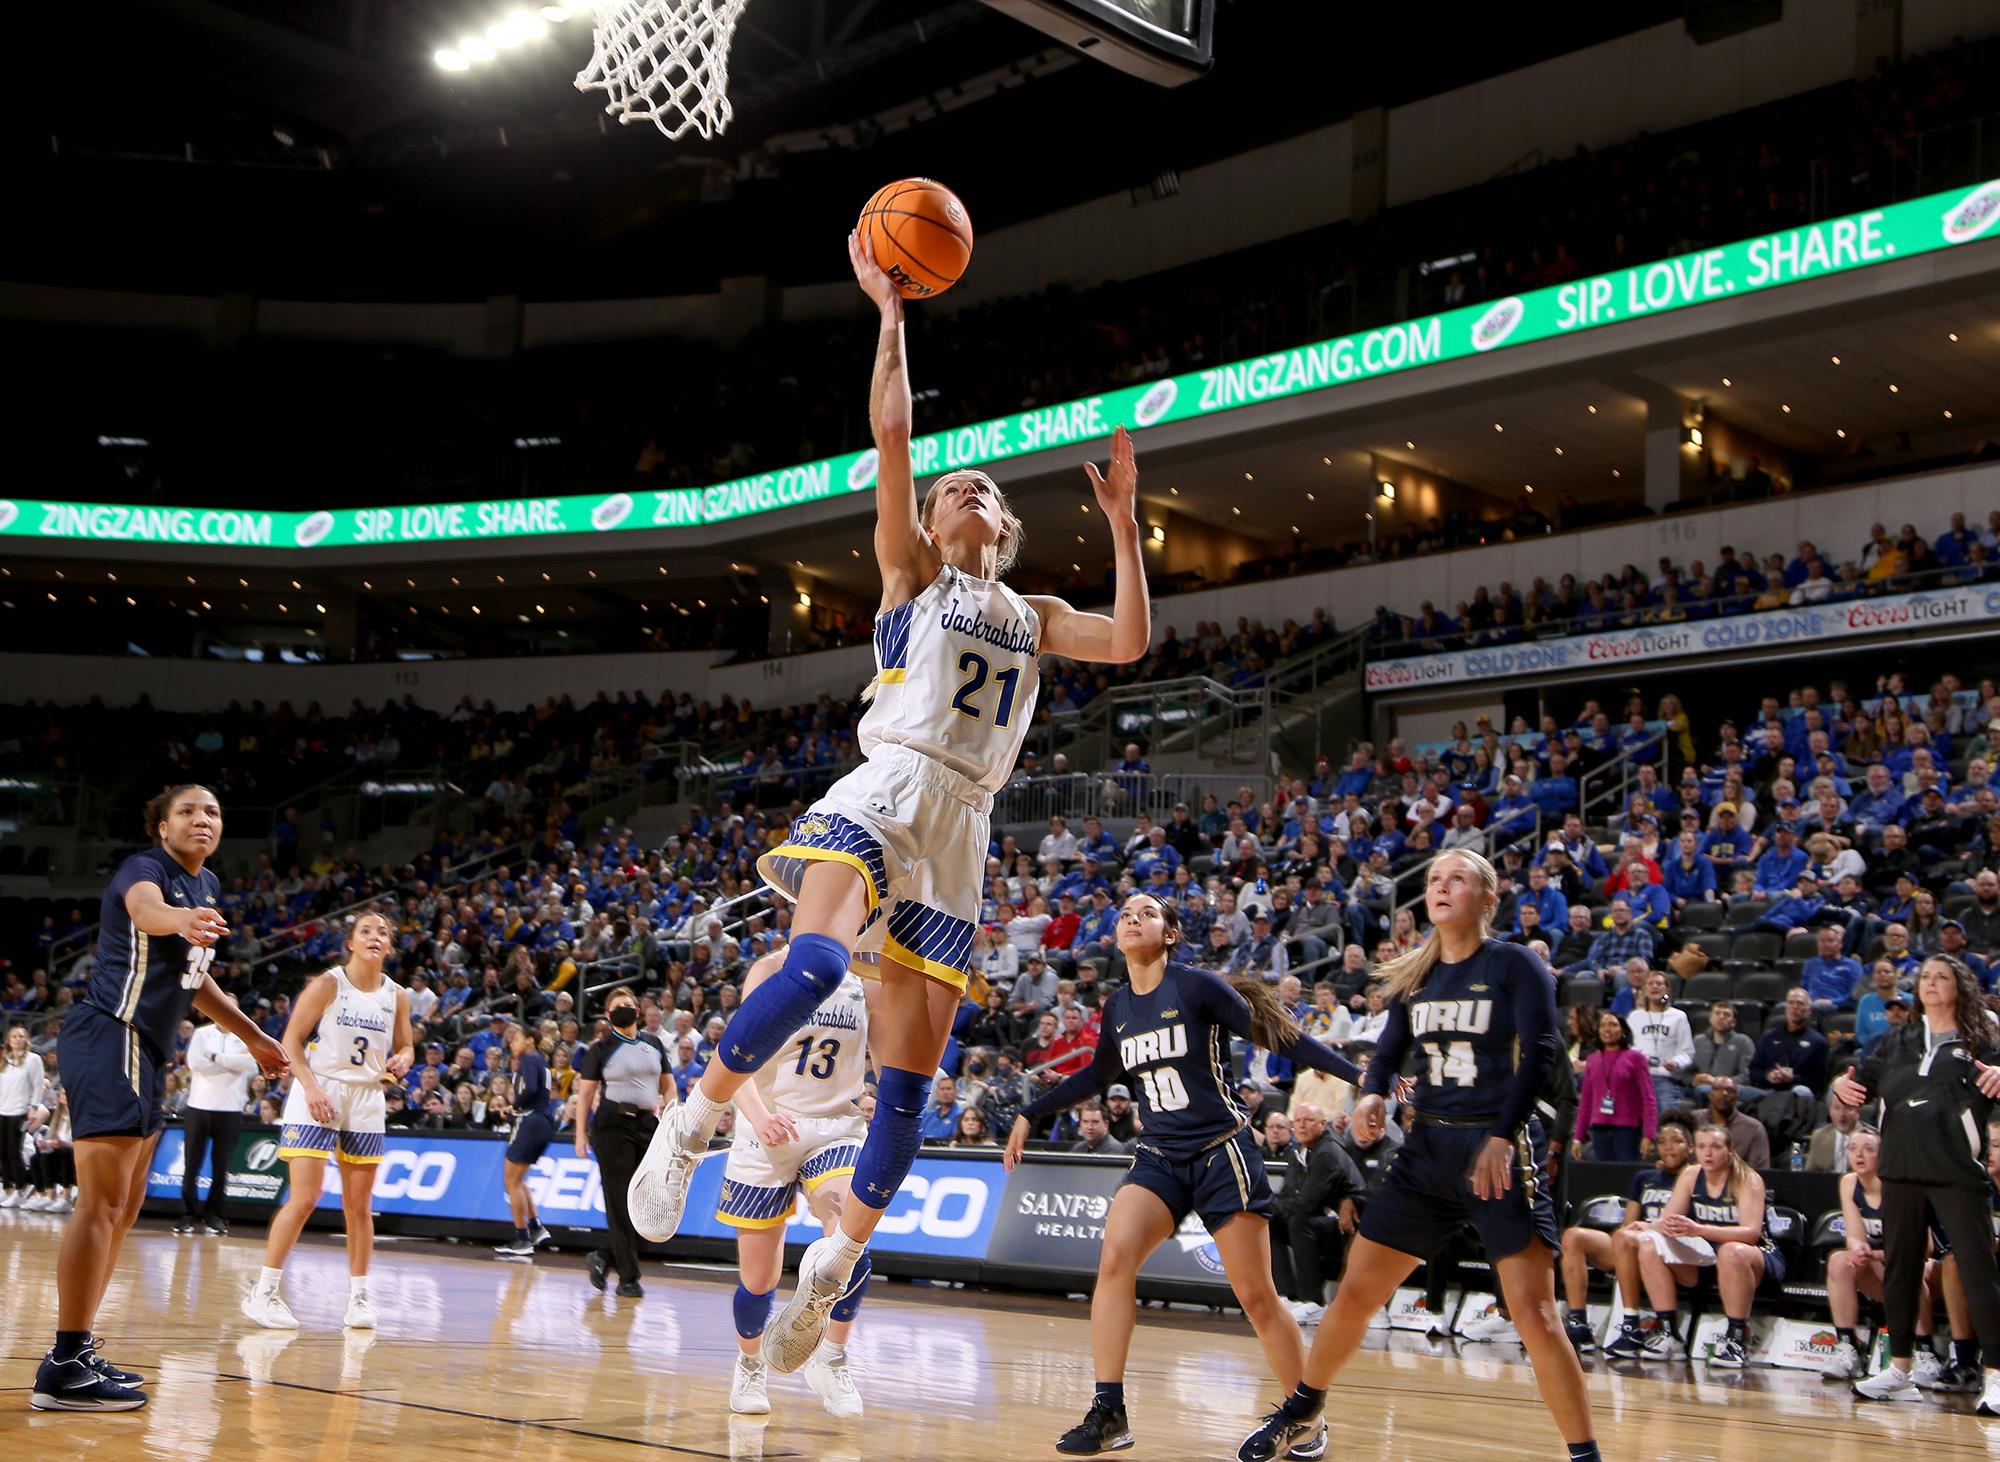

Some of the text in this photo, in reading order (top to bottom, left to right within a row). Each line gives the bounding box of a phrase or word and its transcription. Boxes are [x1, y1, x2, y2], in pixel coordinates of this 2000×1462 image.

[1556, 279, 1615, 329] SIP.
[1628, 251, 1734, 314] LOVE.
[1747, 212, 1895, 285] SHARE.
[1199, 317, 1441, 410] ZINGZANG.COM
[946, 419, 1013, 465] LOVE.
[1019, 397, 1109, 451] SHARE.
[653, 461, 830, 525] ZINGZANG.COM
[38, 503, 272, 545] ZINGZANG.COM
[353, 509, 394, 541] SIP.
[400, 505, 470, 539] LOVE.
[476, 499, 567, 535] SHARE.
[1703, 614, 1823, 648] COLD ZONE
[1847, 603, 1909, 629] Coors
[1913, 599, 1969, 620] LIGHT
[1465, 646, 1567, 676] COLD ZONE
[1587, 633, 1690, 660] Coors LIGHT
[950, 649, 1023, 730] 21
[1414, 662, 1455, 682] LIGHT
[1412, 1000, 1493, 1038] ORU
[350, 1036, 369, 1067] 3
[795, 1035, 841, 1080] 13
[1120, 1023, 1188, 1071] ORU
[1421, 1041, 1478, 1087] 14
[1138, 1066, 1190, 1112] 10
